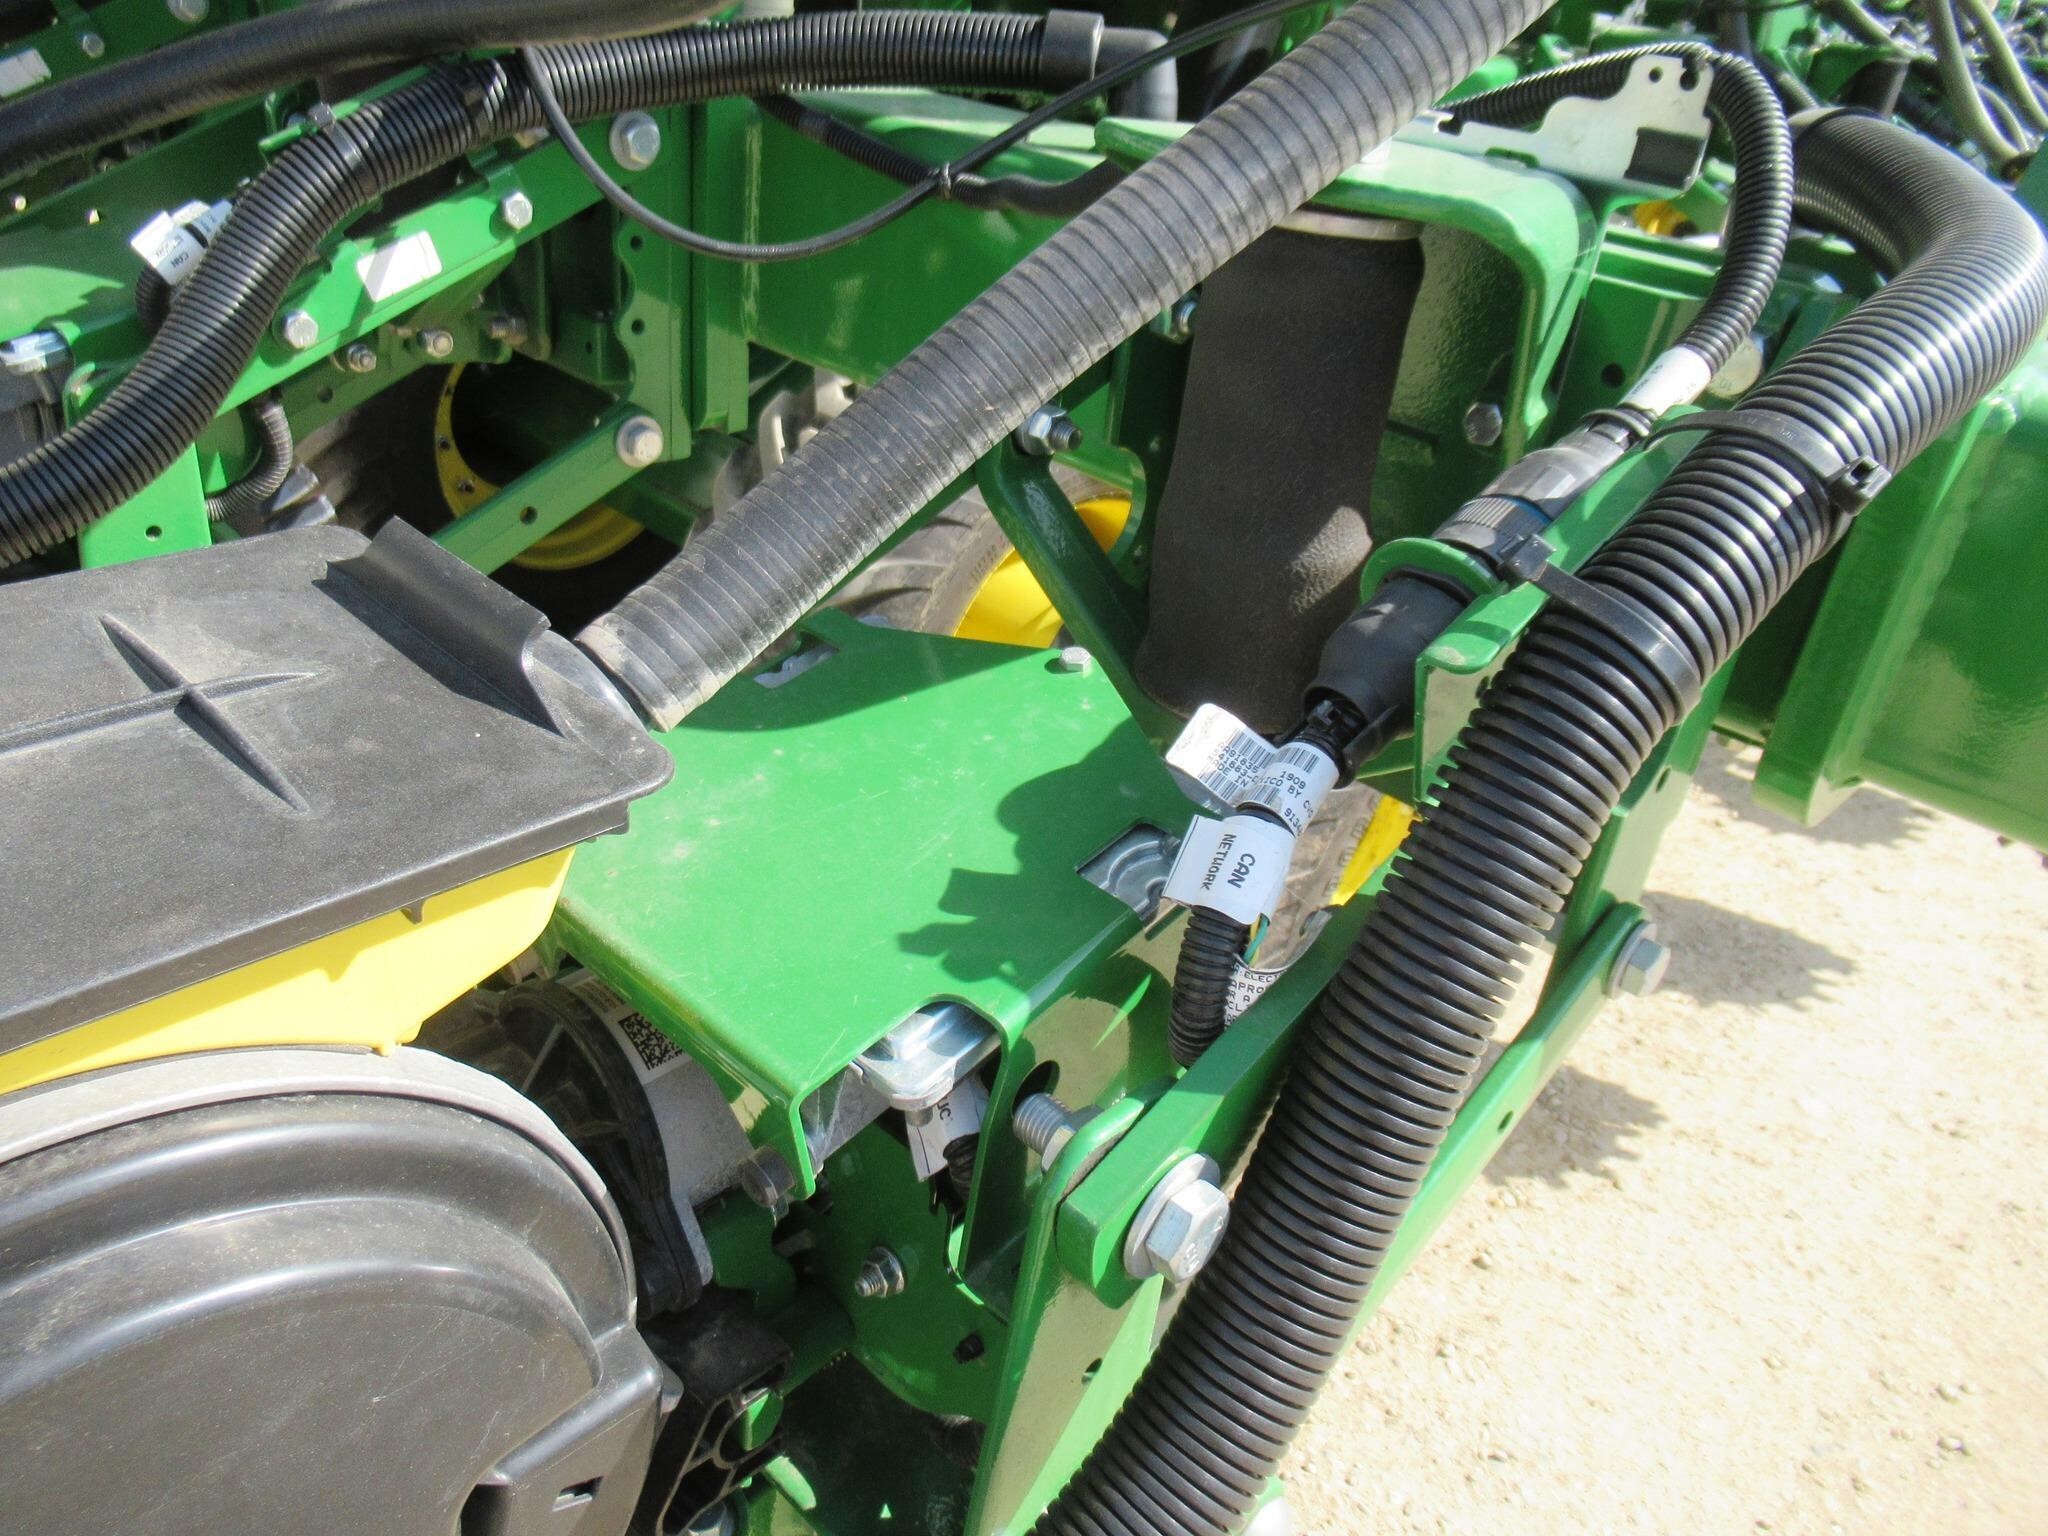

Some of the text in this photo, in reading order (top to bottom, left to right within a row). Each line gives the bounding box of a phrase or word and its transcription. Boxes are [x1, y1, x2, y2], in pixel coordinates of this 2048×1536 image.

[1234, 775, 1249, 788] IN
[1287, 784, 1302, 798] BY
[1280, 770, 1306, 790] 1909
[1200, 833, 1237, 890] NETWORK
[1227, 853, 1256, 888] CAN
